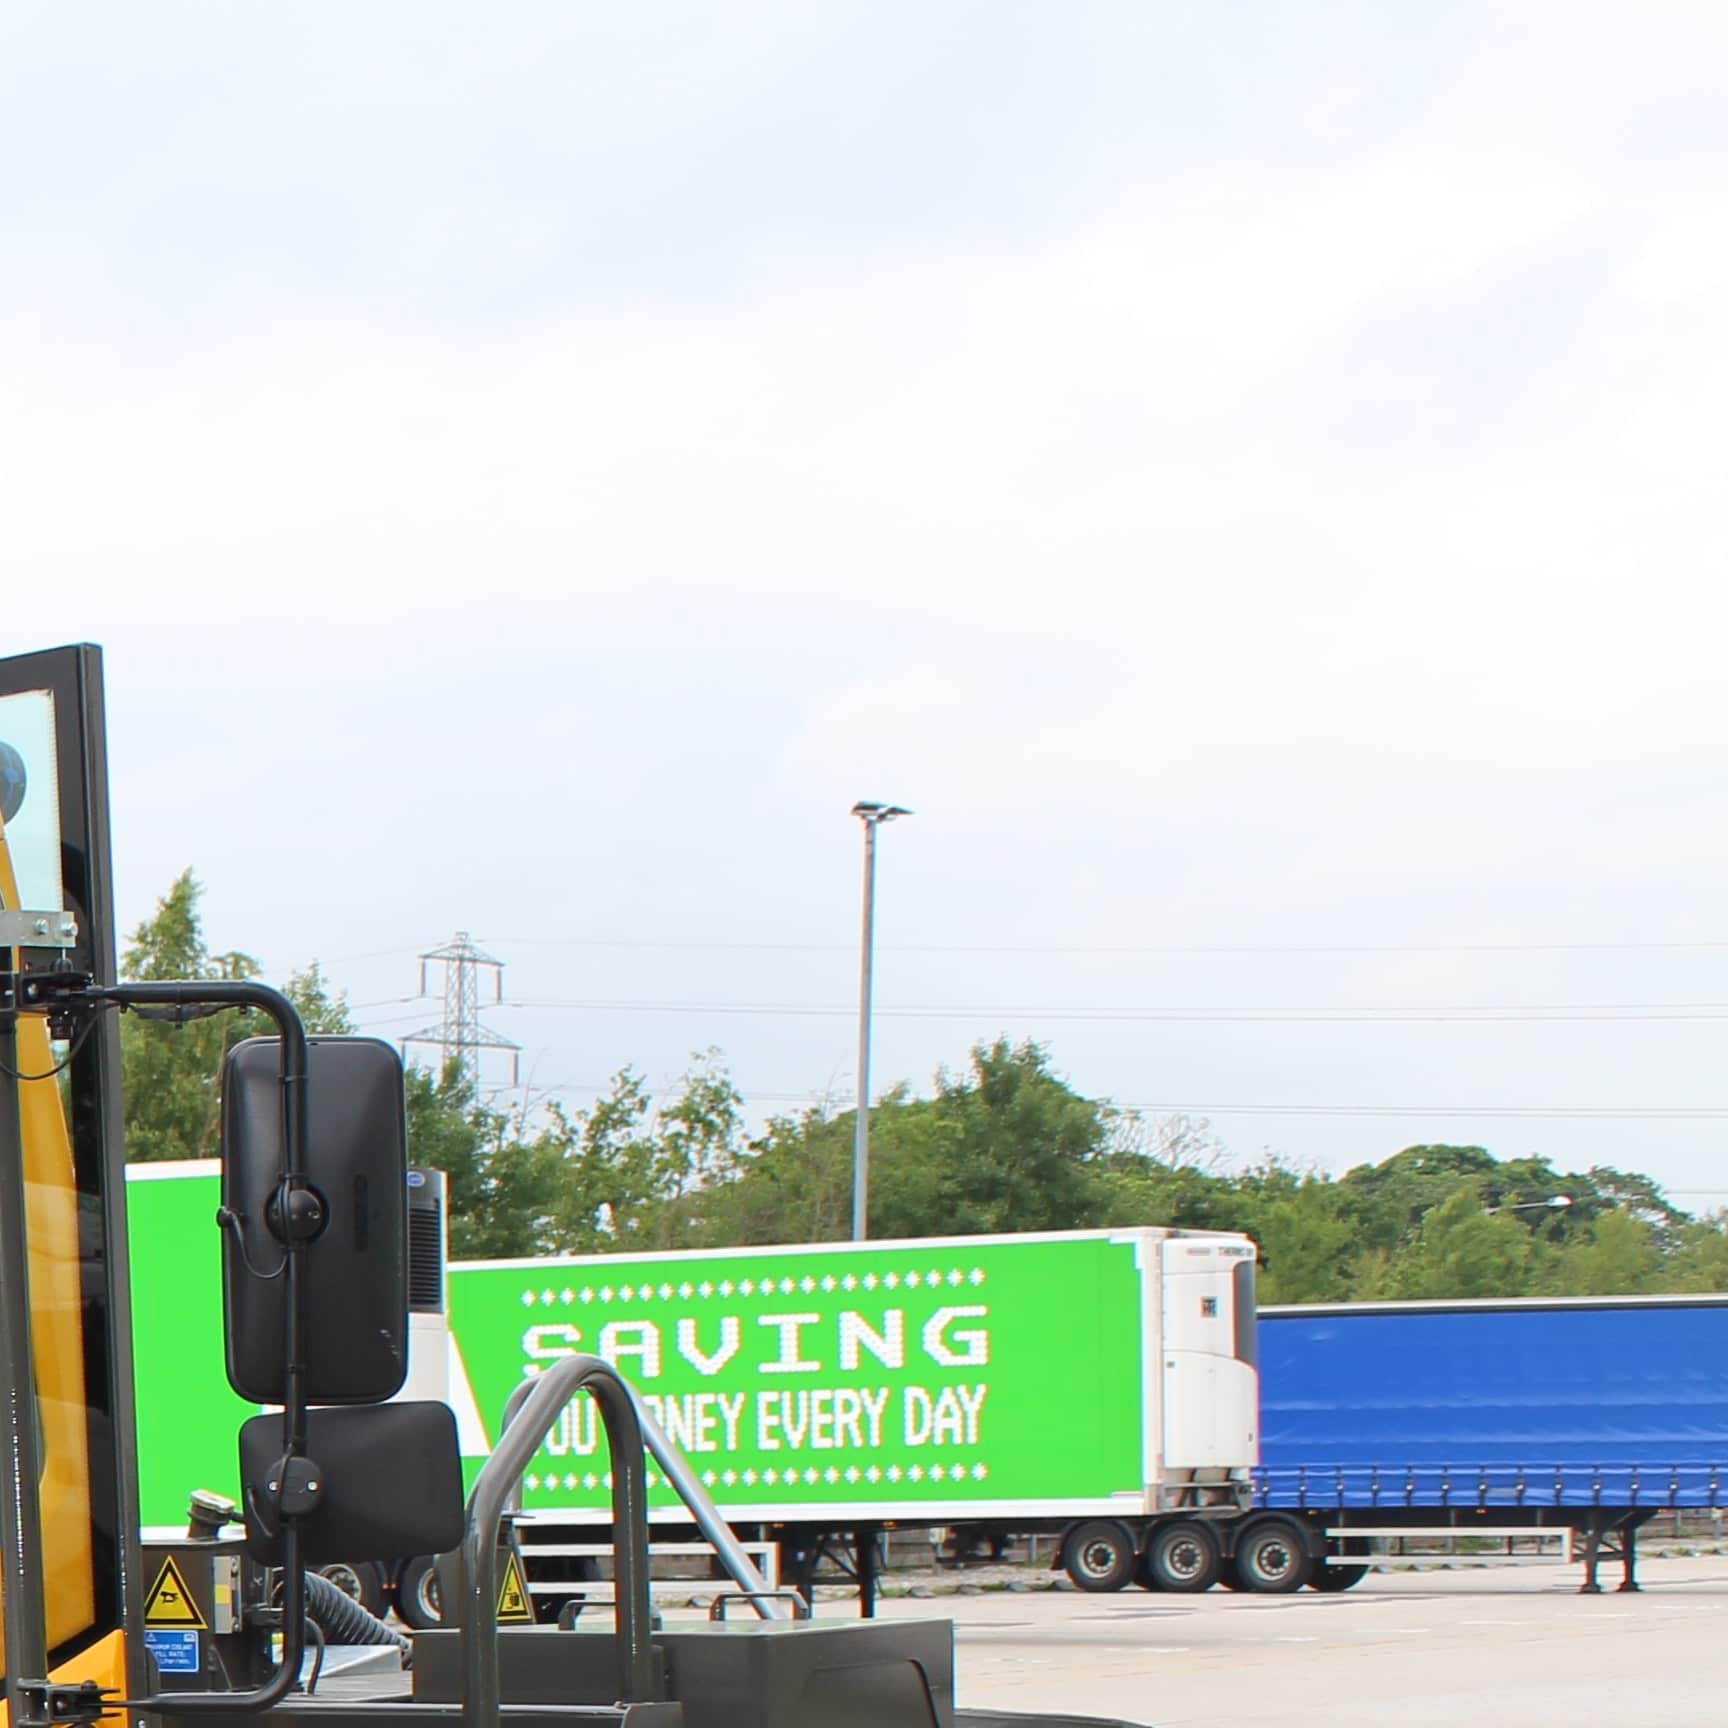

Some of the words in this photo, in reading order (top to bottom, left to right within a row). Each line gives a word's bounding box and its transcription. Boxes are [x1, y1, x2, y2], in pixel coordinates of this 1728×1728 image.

[522, 1305, 989, 1377] SAVING
[536, 1396, 597, 1456] OU
[642, 1392, 745, 1452] NEY
[757, 1387, 889, 1450] EVERY
[904, 1383, 988, 1446] DAY
